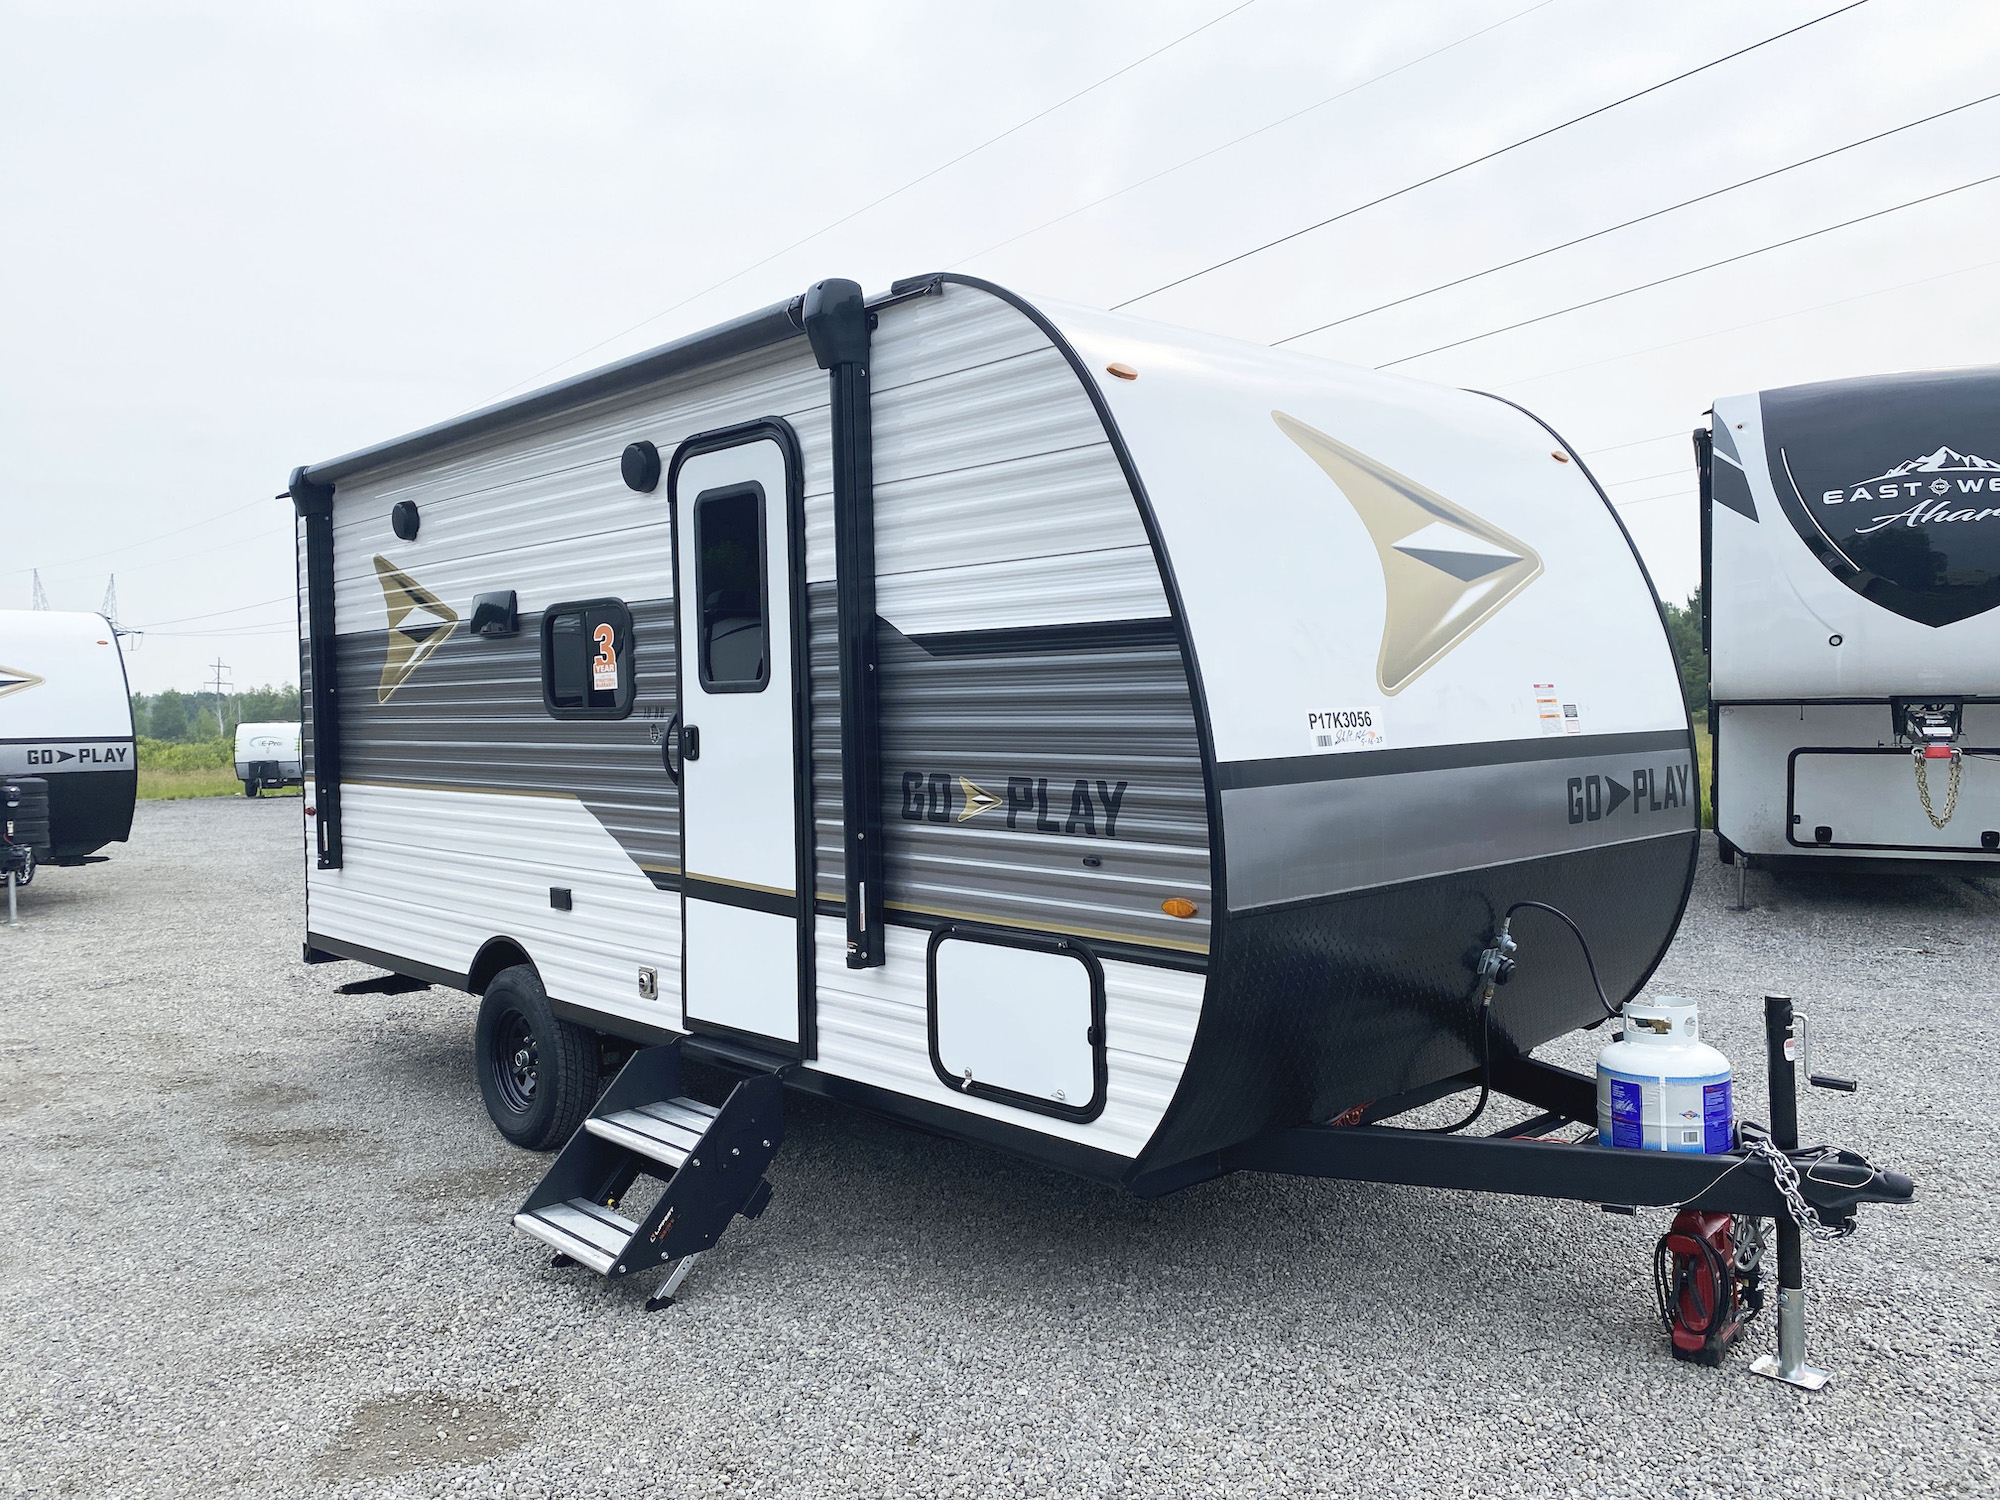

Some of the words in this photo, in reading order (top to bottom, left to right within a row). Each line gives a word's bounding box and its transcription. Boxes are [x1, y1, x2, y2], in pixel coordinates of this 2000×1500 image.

[1822, 481, 1924, 505] EAST
[594, 623, 616, 666] 3
[595, 664, 615, 673] YEAR
[1308, 711, 1372, 729] P17K3056
[27, 749, 54, 765] GO
[78, 748, 128, 763] PLAY
[902, 771, 952, 823] GO
[1007, 776, 1129, 837] PLAY
[1567, 774, 1601, 825] GO
[1632, 764, 1689, 815] PLAY
